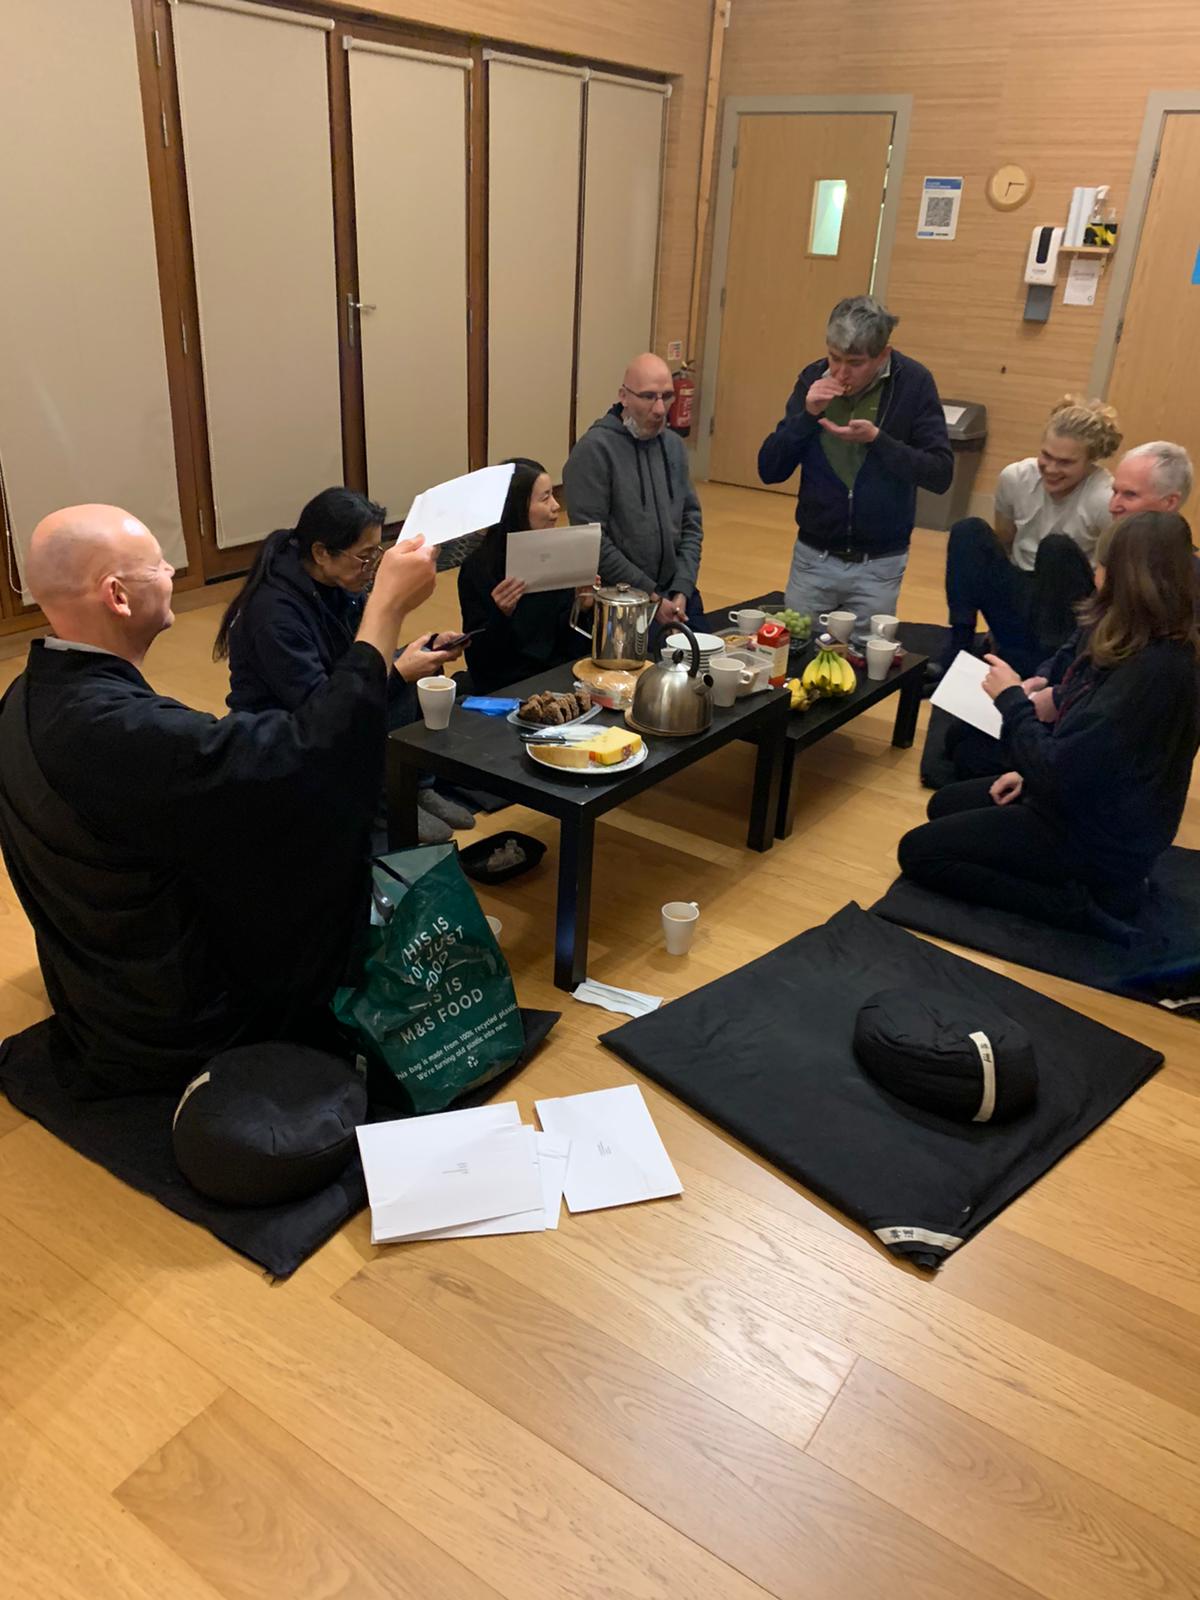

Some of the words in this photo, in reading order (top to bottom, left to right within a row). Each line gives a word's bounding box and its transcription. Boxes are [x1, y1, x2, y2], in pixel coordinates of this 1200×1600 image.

[427, 925, 464, 960] JUST
[432, 916, 449, 935] IS
[426, 951, 448, 993] FOOD
[445, 977, 462, 996] IS
[400, 1016, 436, 1045] M&S
[437, 988, 483, 1023] FOOD
[396, 1070, 408, 1081] his
[408, 1062, 423, 1075] bag
[421, 1058, 429, 1066] is
[428, 1049, 443, 1062] made
[443, 1039, 460, 1052] from
[459, 1030, 475, 1042] 100%
[474, 1014, 498, 1034] recycled
[416, 1067, 436, 1081] We're
[434, 1054, 457, 1071] turning
[455, 1047, 467, 1057] old
[466, 1036, 485, 1051] plastic
[483, 1028, 496, 1039] into
